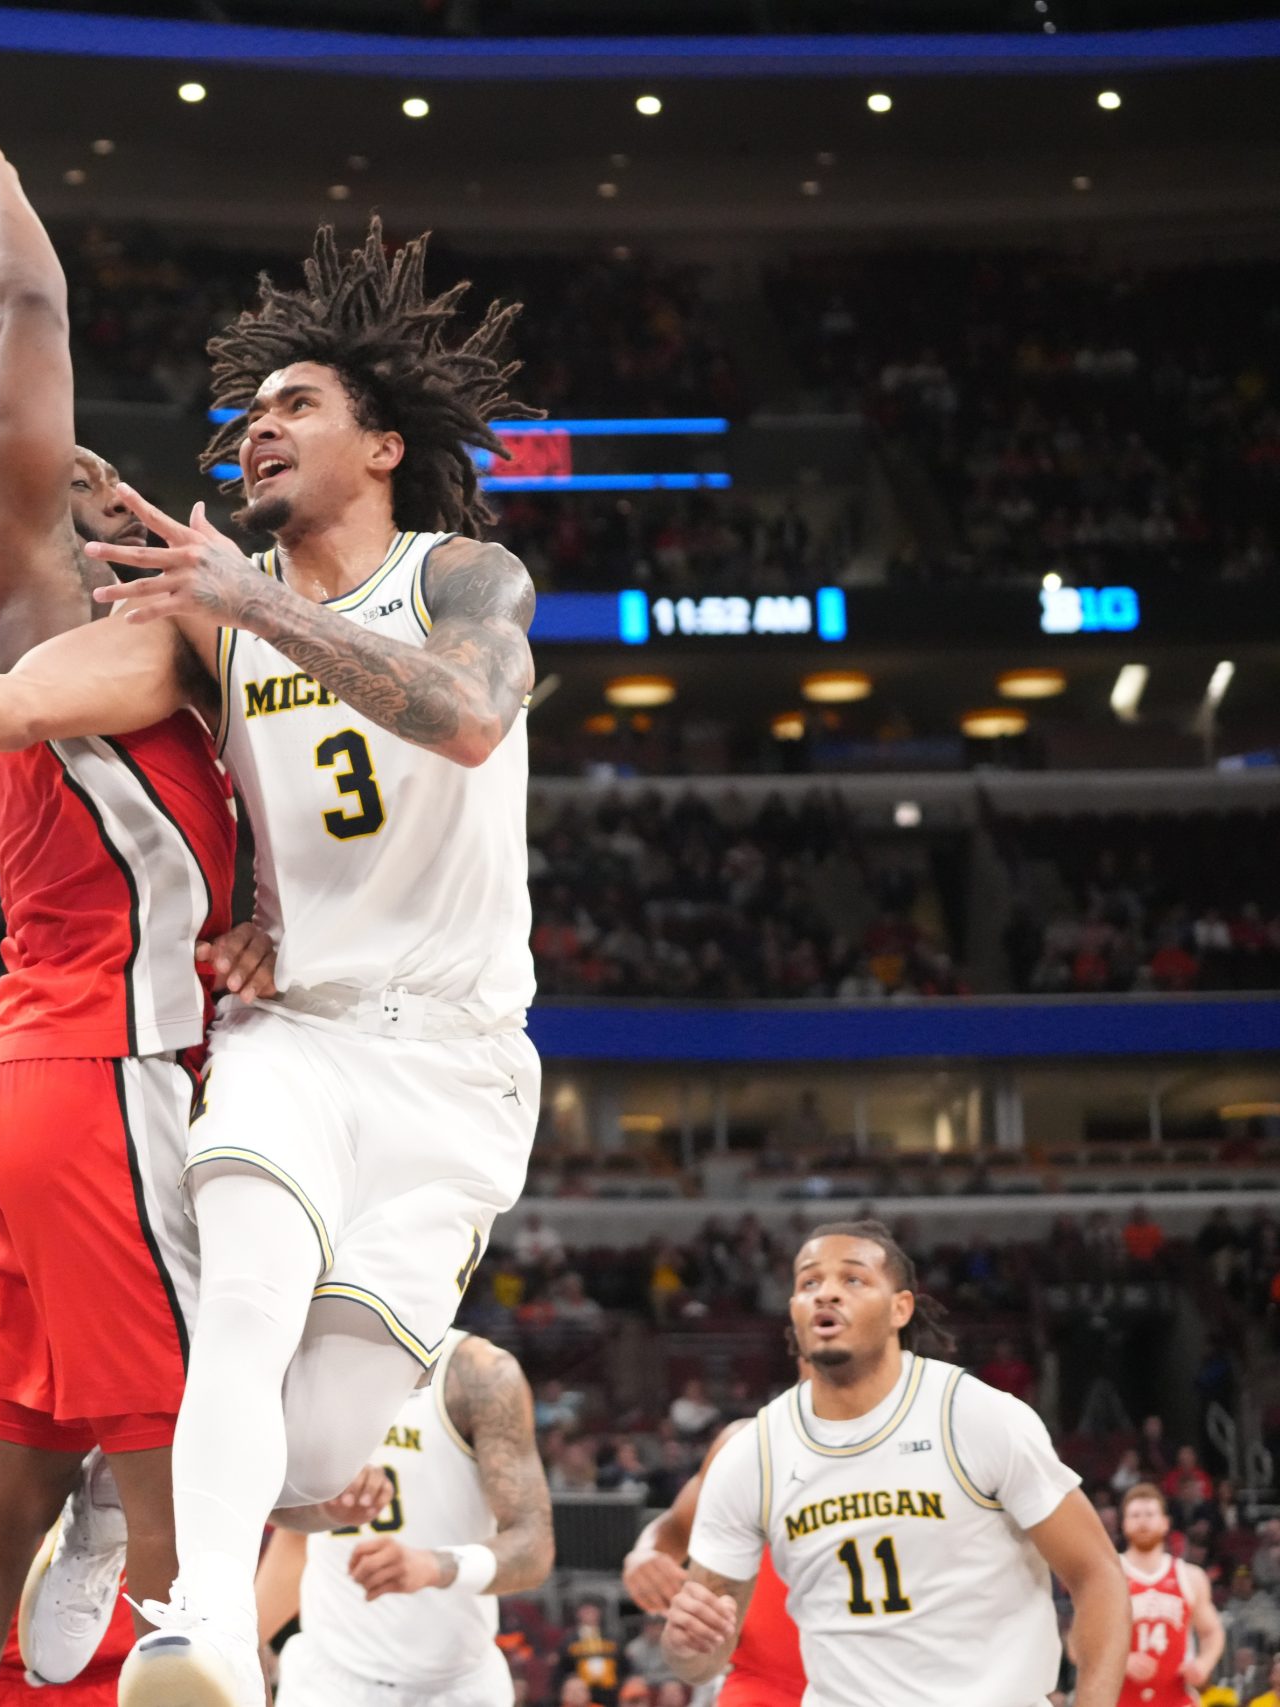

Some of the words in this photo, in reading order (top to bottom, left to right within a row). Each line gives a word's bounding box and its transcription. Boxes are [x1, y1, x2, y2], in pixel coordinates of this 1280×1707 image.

[753, 595, 812, 635] AM
[315, 727, 387, 841] 3
[783, 1488, 947, 1542] MICHIGAN
[836, 1535, 913, 1617] 11
